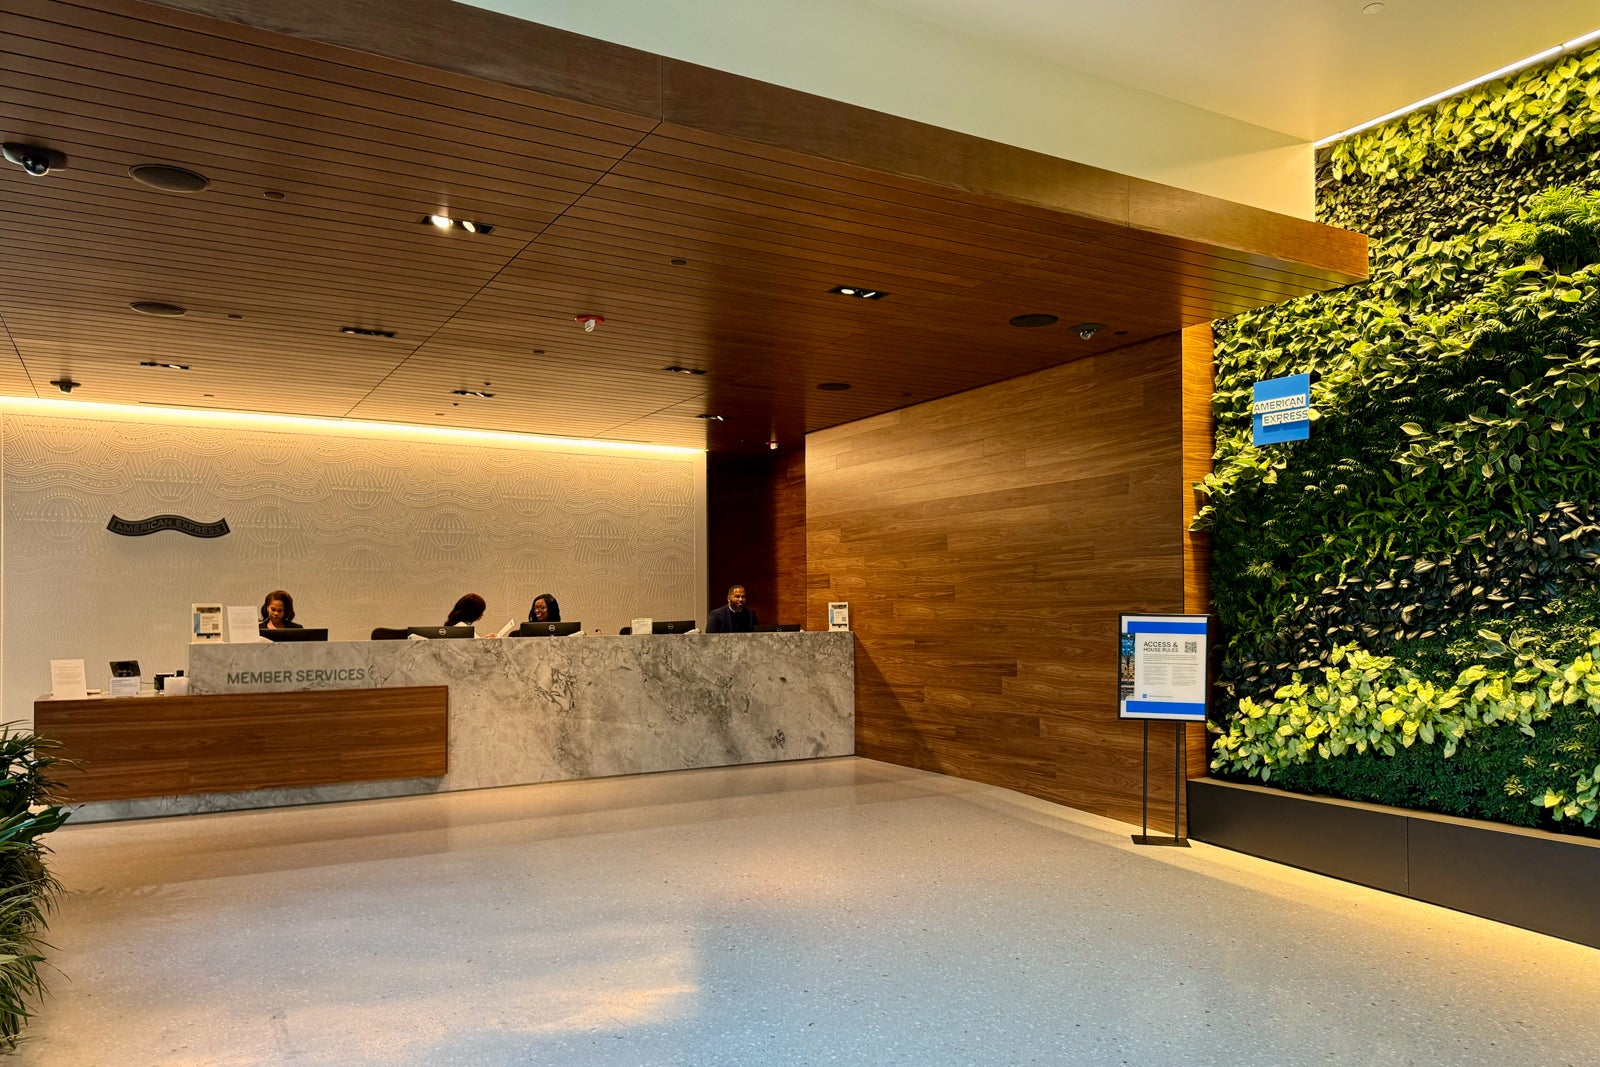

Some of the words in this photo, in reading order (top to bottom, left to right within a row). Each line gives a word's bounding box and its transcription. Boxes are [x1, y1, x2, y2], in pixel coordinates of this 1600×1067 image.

[1254, 396, 1304, 412] AMERICAN
[1264, 410, 1308, 424] EXPRESS
[118, 432, 173, 445] AMERICAN
[68, 472, 118, 487] EXPRESS
[116, 518, 173, 533] AMERICAN
[175, 520, 221, 534] EXPRESS
[227, 670, 292, 685] MEMBER
[296, 668, 365, 682] SERVICES
